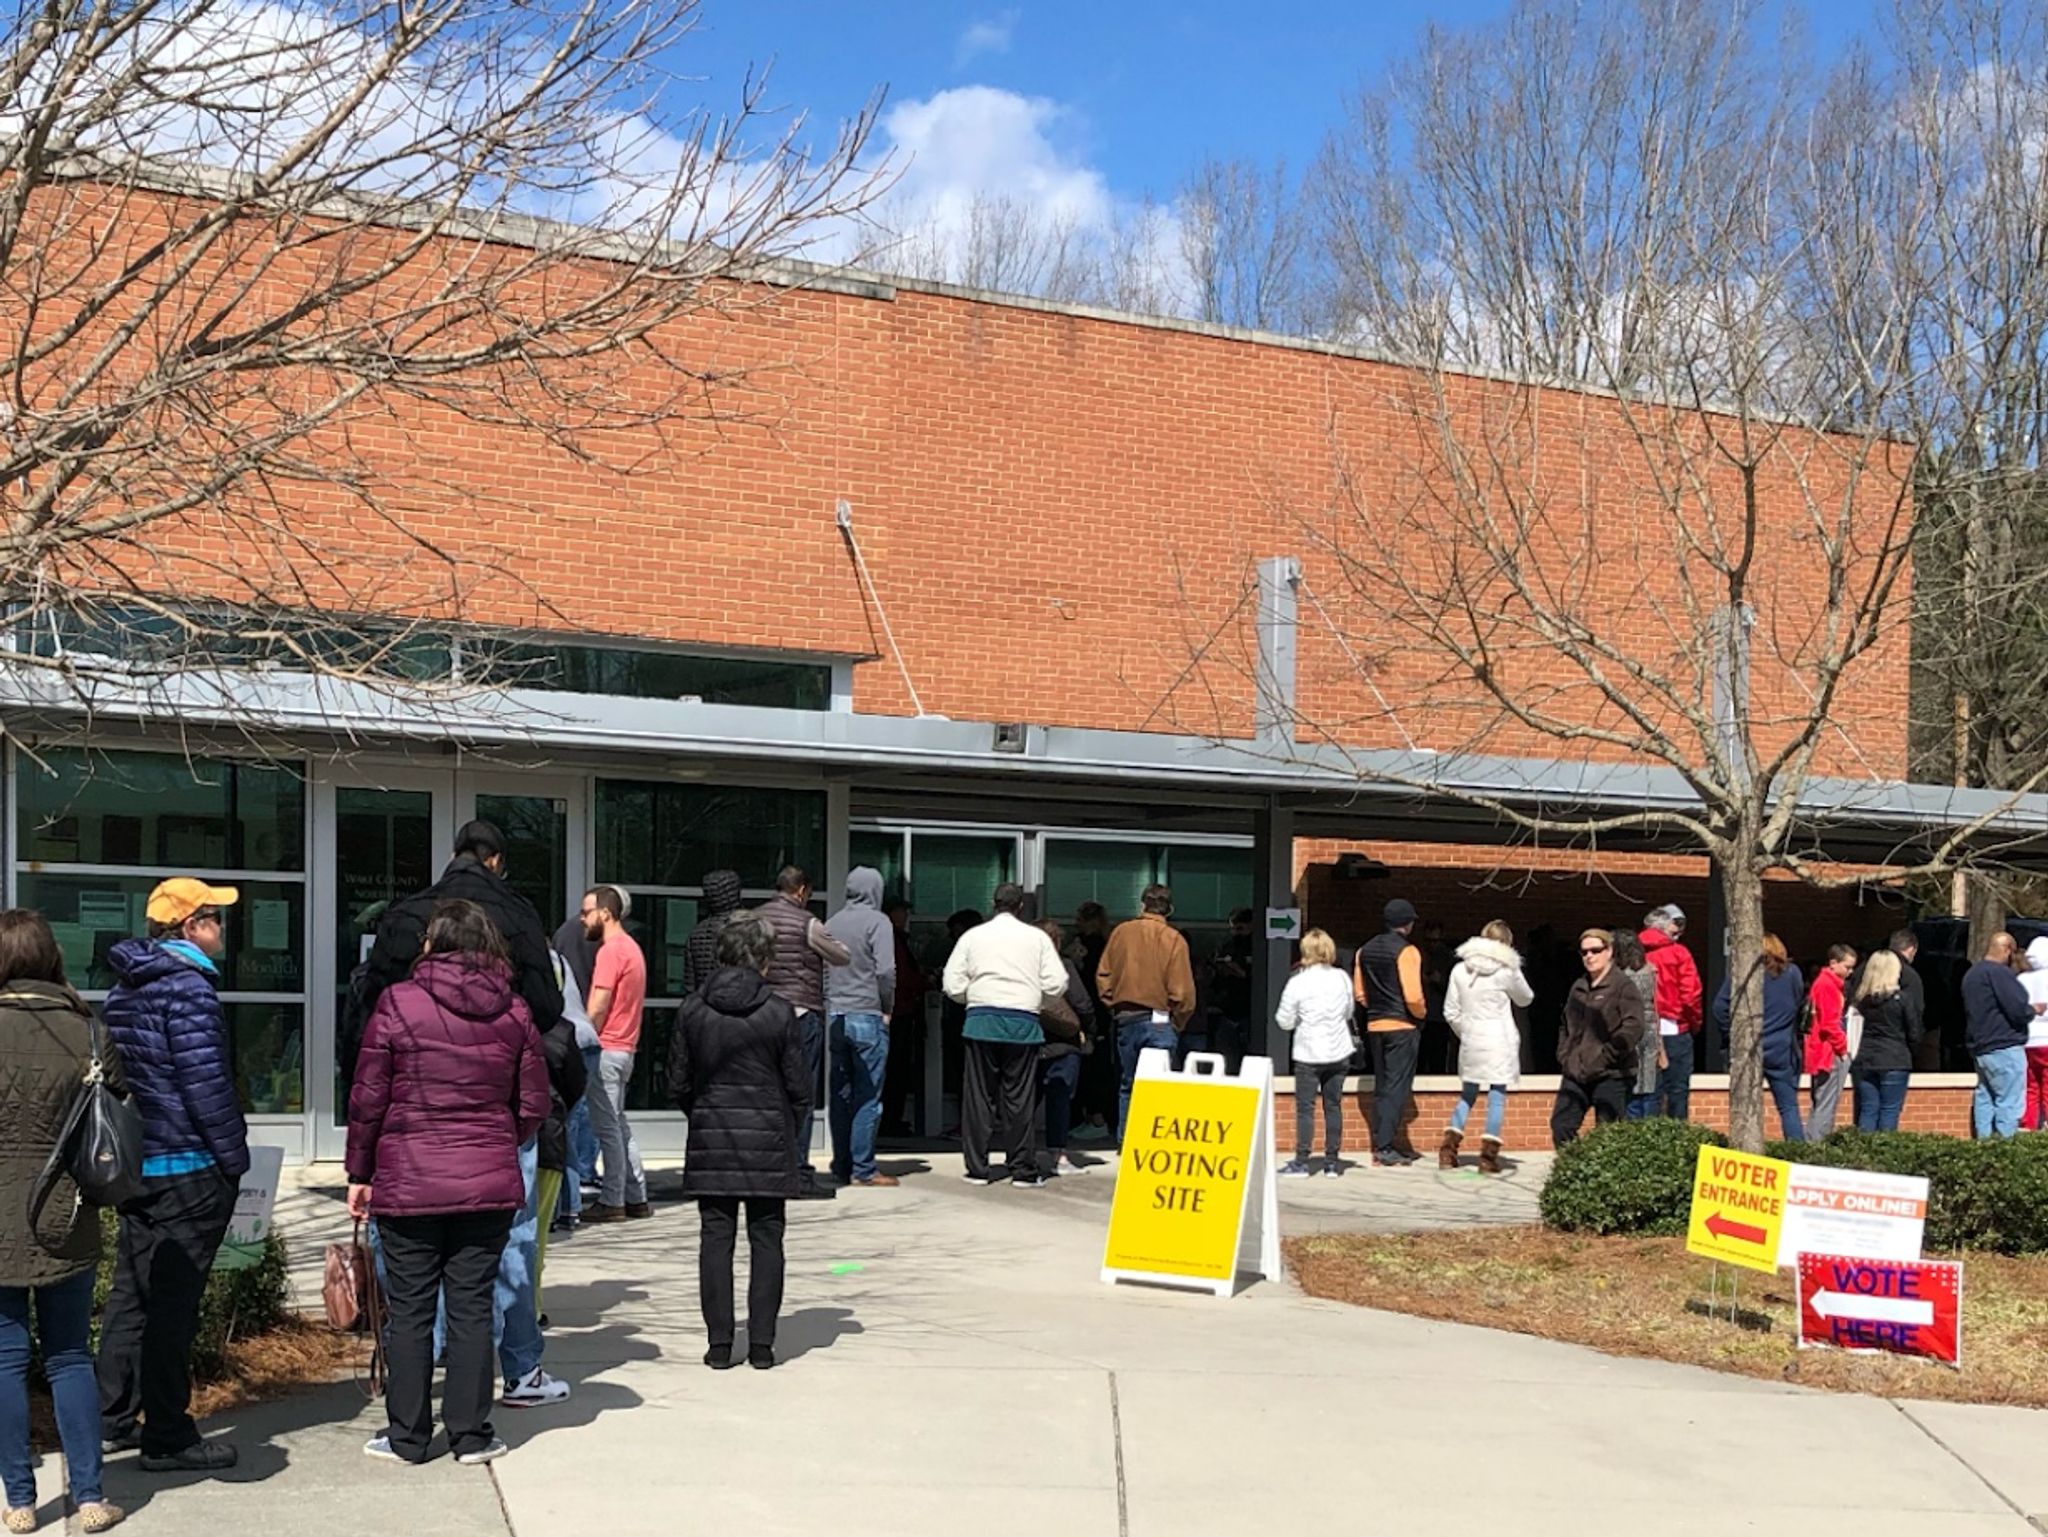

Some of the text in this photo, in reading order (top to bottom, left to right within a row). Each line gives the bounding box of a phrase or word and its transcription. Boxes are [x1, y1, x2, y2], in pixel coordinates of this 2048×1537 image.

[1151, 1115, 1233, 1144] EARLY
[1133, 1148, 1240, 1181] VOTING
[1712, 1156, 1778, 1190] VOTER
[1152, 1185, 1206, 1213] SITE
[1700, 1182, 1781, 1216] ENTRANCE
[1843, 1194, 1918, 1216] ONLINE!
[1832, 1264, 1920, 1298] VOTE
[1831, 1317, 1919, 1348] HERE
